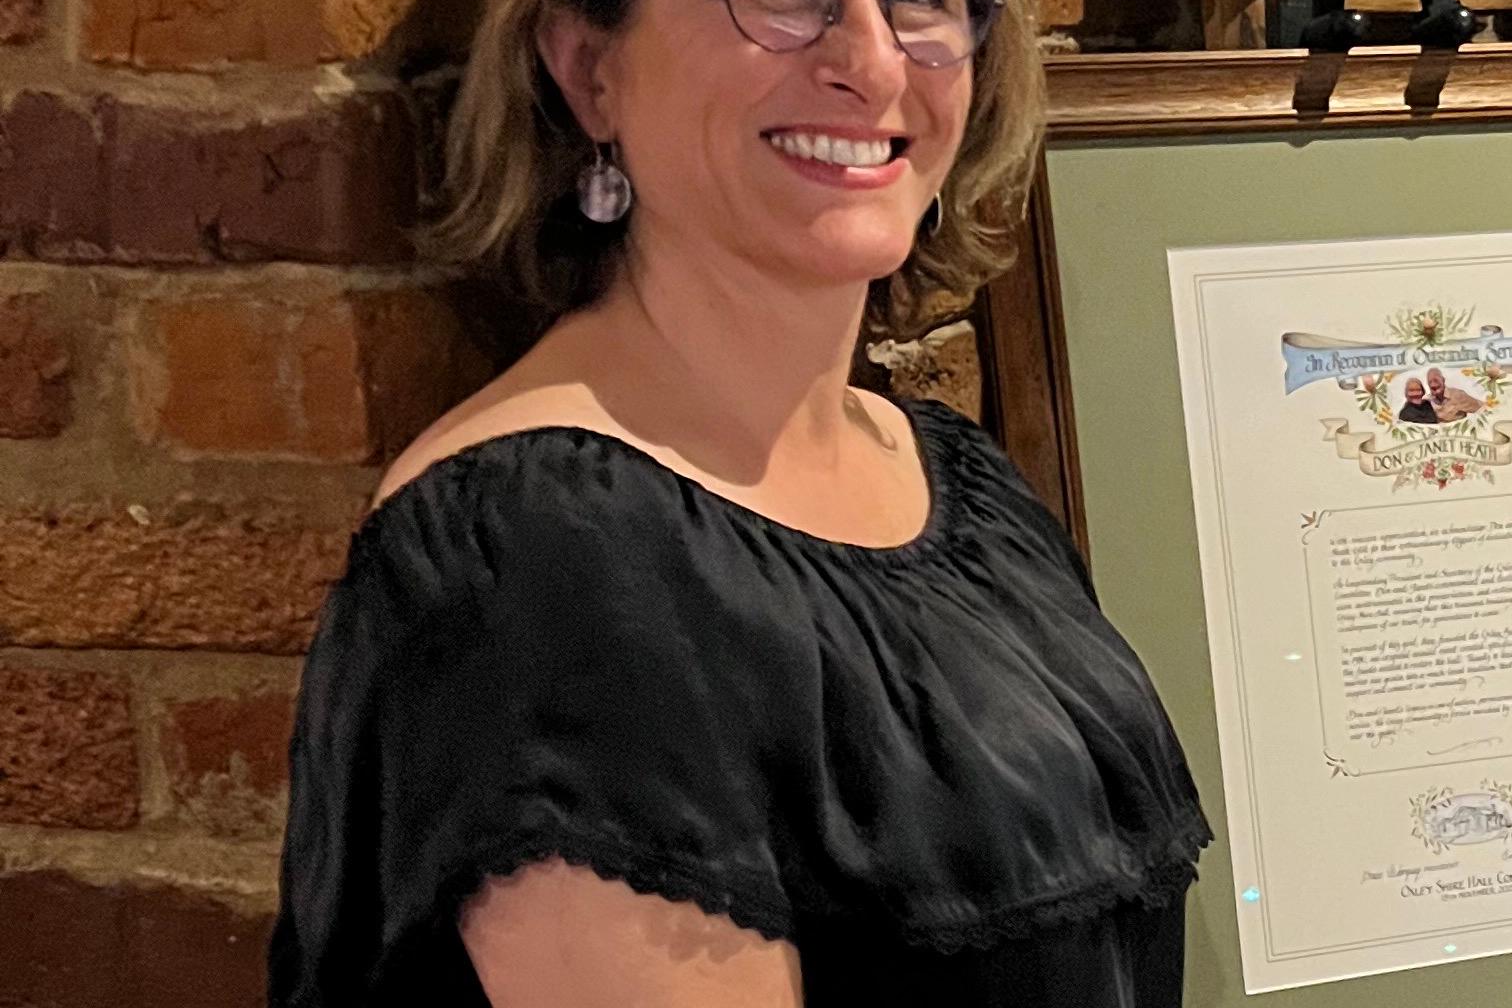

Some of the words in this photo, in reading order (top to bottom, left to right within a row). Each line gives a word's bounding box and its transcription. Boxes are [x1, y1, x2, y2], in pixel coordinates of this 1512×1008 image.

[1304, 354, 1323, 373] In
[1413, 346, 1480, 366] Outstanding
[1373, 455, 1401, 472] DON
[1414, 440, 1456, 460] JANET
[1459, 442, 1498, 462] HEATH
[1467, 875, 1493, 889] HALL
